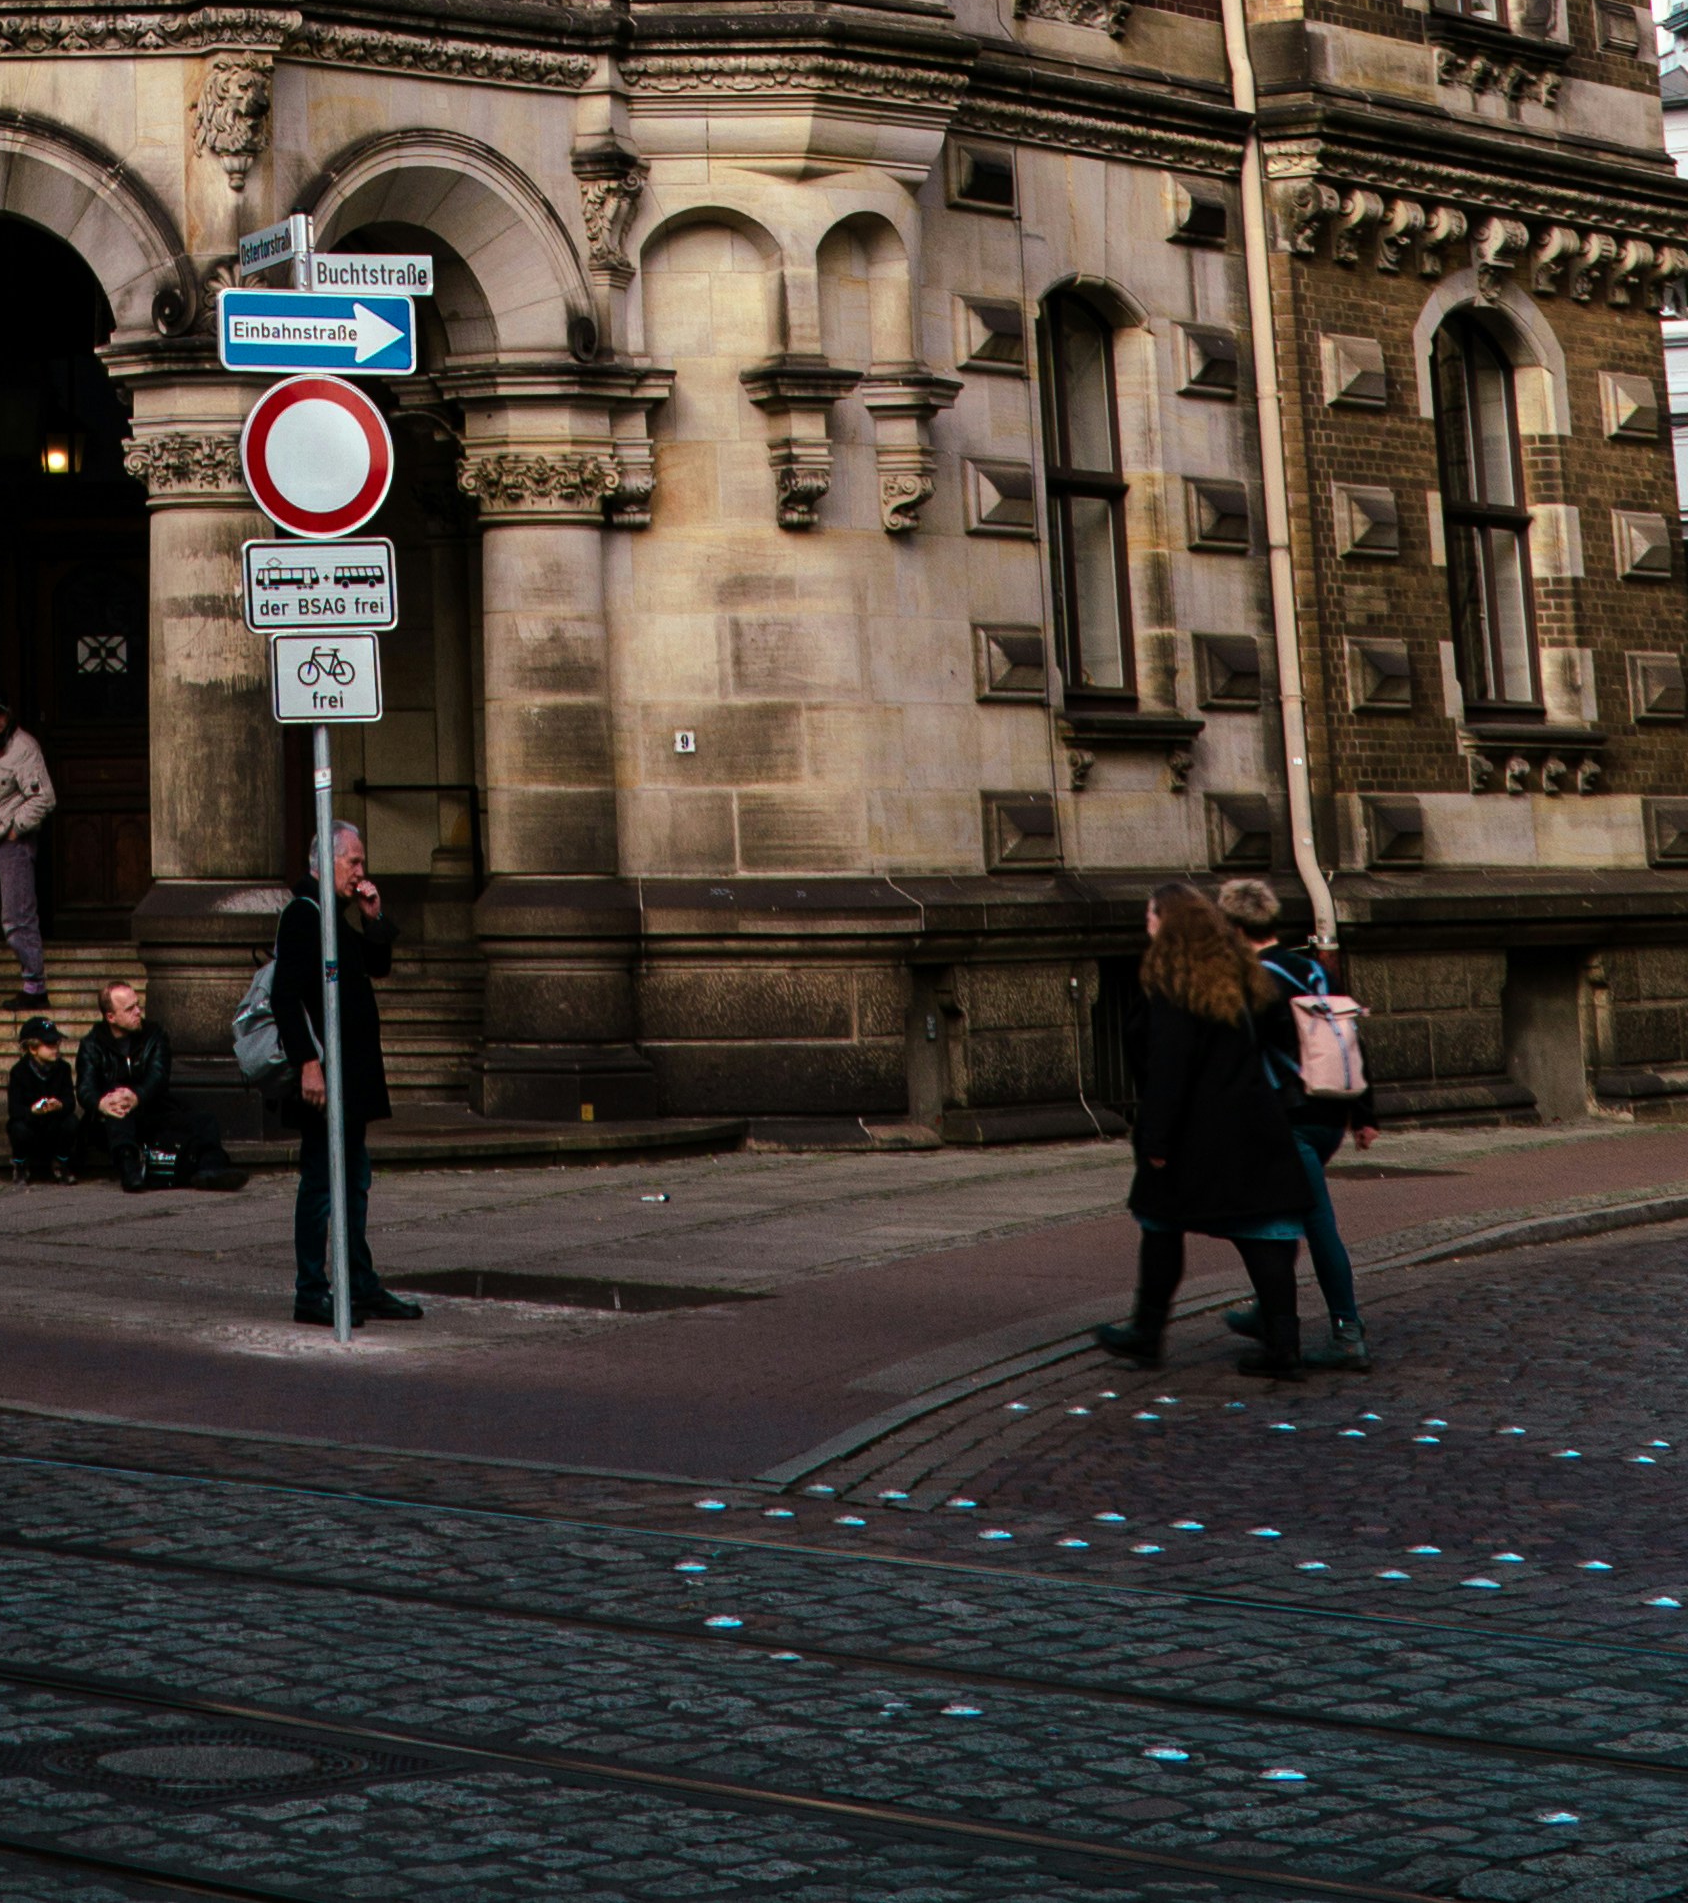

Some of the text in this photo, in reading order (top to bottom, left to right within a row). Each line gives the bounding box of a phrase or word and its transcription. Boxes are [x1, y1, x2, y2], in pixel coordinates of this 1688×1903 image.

[241, 227, 291, 266] Ostertorstraß
[317, 262, 428, 286] Buchtstraße
[234, 322, 358, 342] Einbahnstraße
[260, 597, 385, 616] der BSAG frei
[312, 691, 344, 710] frei
[680, 733, 690, 750] 9
